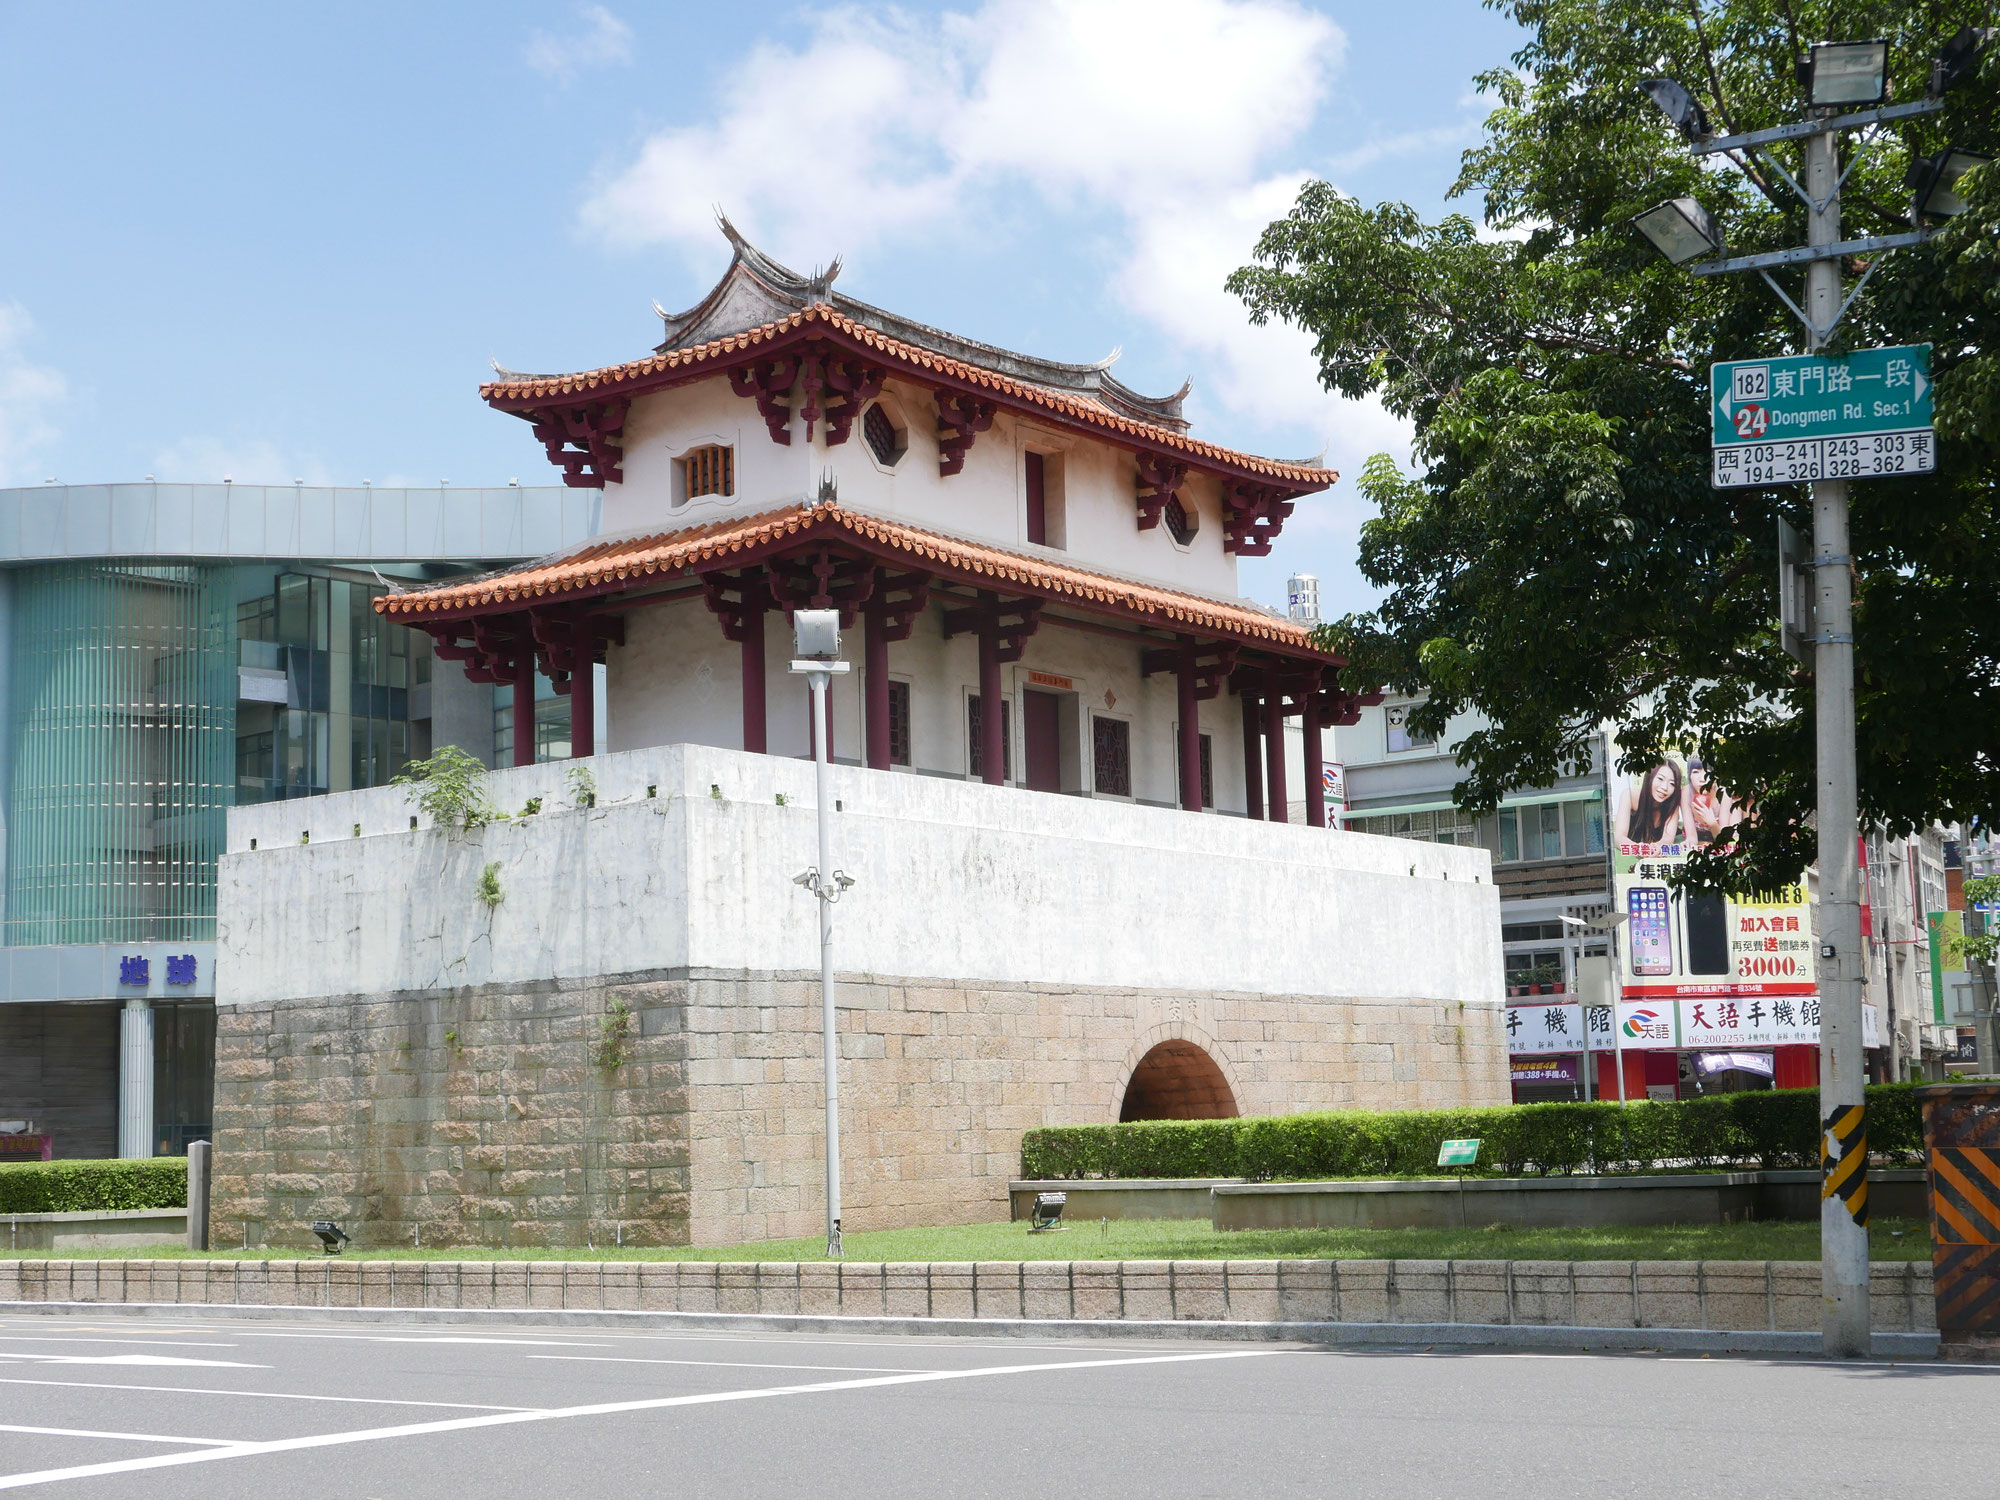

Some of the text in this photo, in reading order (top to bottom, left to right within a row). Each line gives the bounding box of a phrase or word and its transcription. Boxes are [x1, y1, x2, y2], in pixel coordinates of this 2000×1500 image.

[1737, 359, 1911, 398] 182 東門路一段
[1737, 400, 1911, 436] 24 Dongmen Rd. Sec.1
[1909, 434, 1931, 456] 東
[1718, 450, 1740, 470] 西
[1919, 457, 1932, 469] E.
[1718, 473, 1736, 484] W.
[1793, 888, 1802, 904] 8
[1741, 916, 1799, 932] 加入會員
[1731, 937, 1810, 952] 再免費送體驗券
[1642, 1024, 1669, 1039] 天語
[1688, 1034, 1745, 1045] 06-2002255
[1652, 1091, 1674, 1099] iPhone
